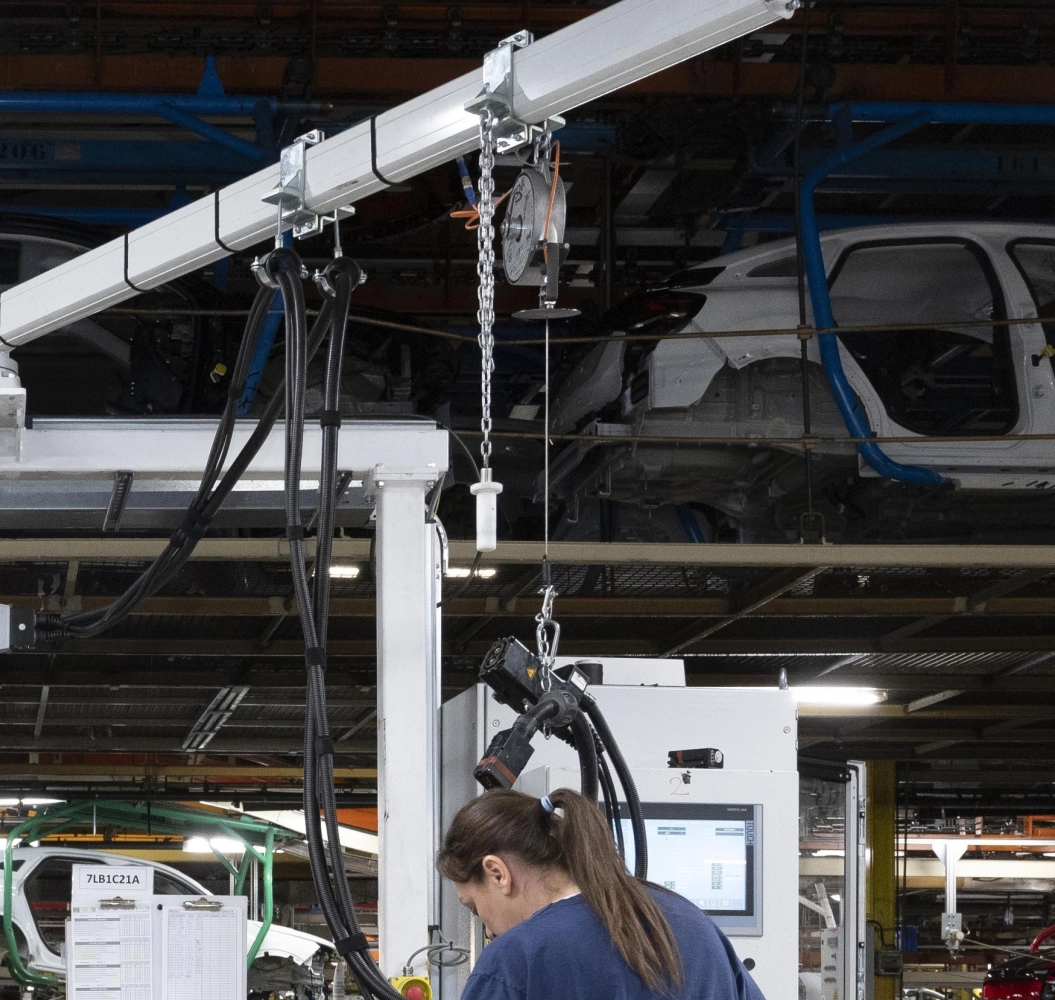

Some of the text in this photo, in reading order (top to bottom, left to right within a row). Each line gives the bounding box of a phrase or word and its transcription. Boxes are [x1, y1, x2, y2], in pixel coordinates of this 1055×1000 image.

[669, 776, 690, 796] 2
[746, 821, 755, 845] TOUCH
[86, 873, 140, 885] 7LB1C21A
